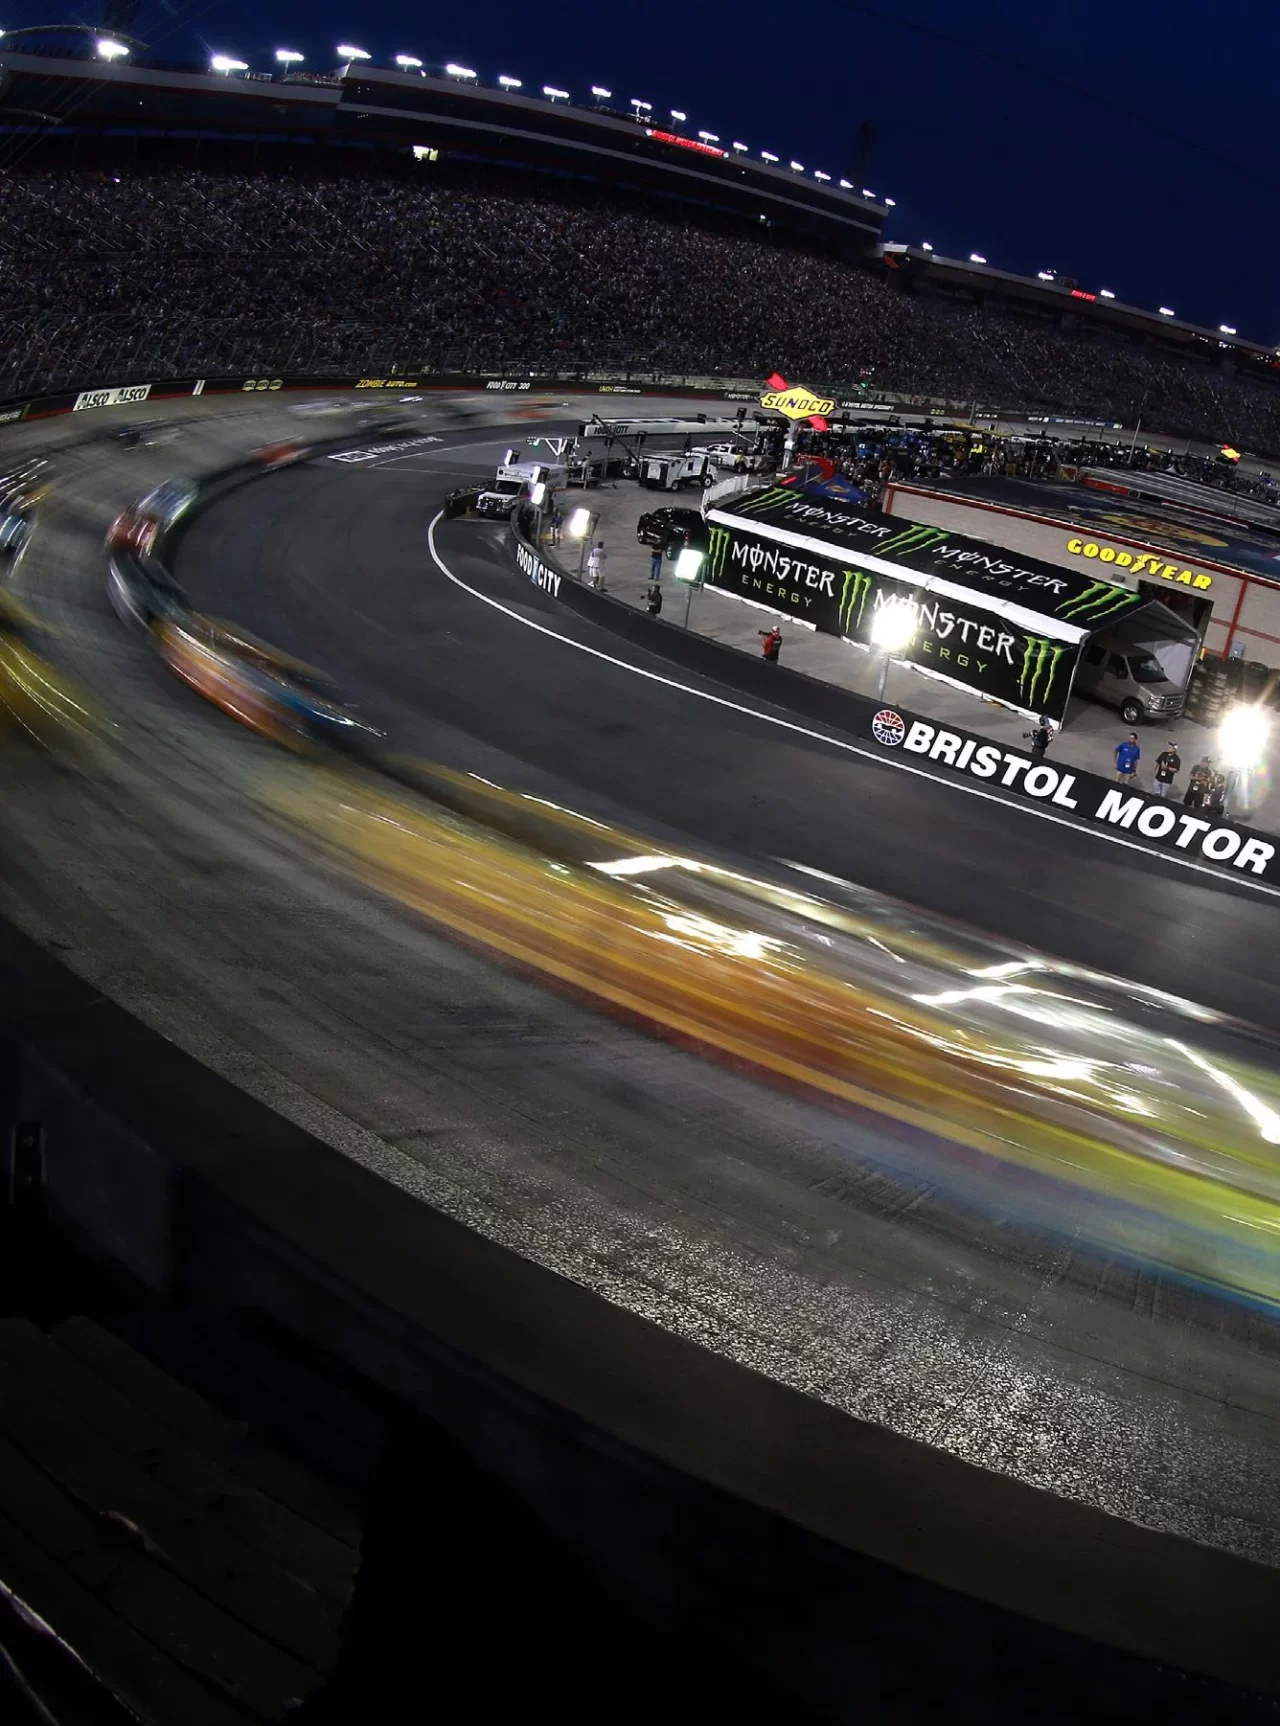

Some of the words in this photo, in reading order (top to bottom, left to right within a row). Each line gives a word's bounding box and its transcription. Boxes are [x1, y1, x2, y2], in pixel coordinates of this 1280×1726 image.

[77, 393, 110, 409] ALSCO
[114, 388, 147, 403] ALSCO
[355, 379, 387, 388] ZOMBIE
[487, 381, 500, 389] FOOD
[764, 395, 832, 413] SUNOCO
[785, 502, 892, 538] MONSTER
[516, 543, 533, 576] FOOD
[538, 563, 561, 598] CITY
[732, 541, 835, 598] MONSTER
[933, 544, 1070, 595] MONSTER
[1067, 538, 1213, 591] GOODYEAR
[742, 575, 813, 607] ENERGY
[908, 636, 988, 673] NERGY
[902, 721, 1079, 808] BRISTOL
[1095, 788, 1277, 876] MOTOR
